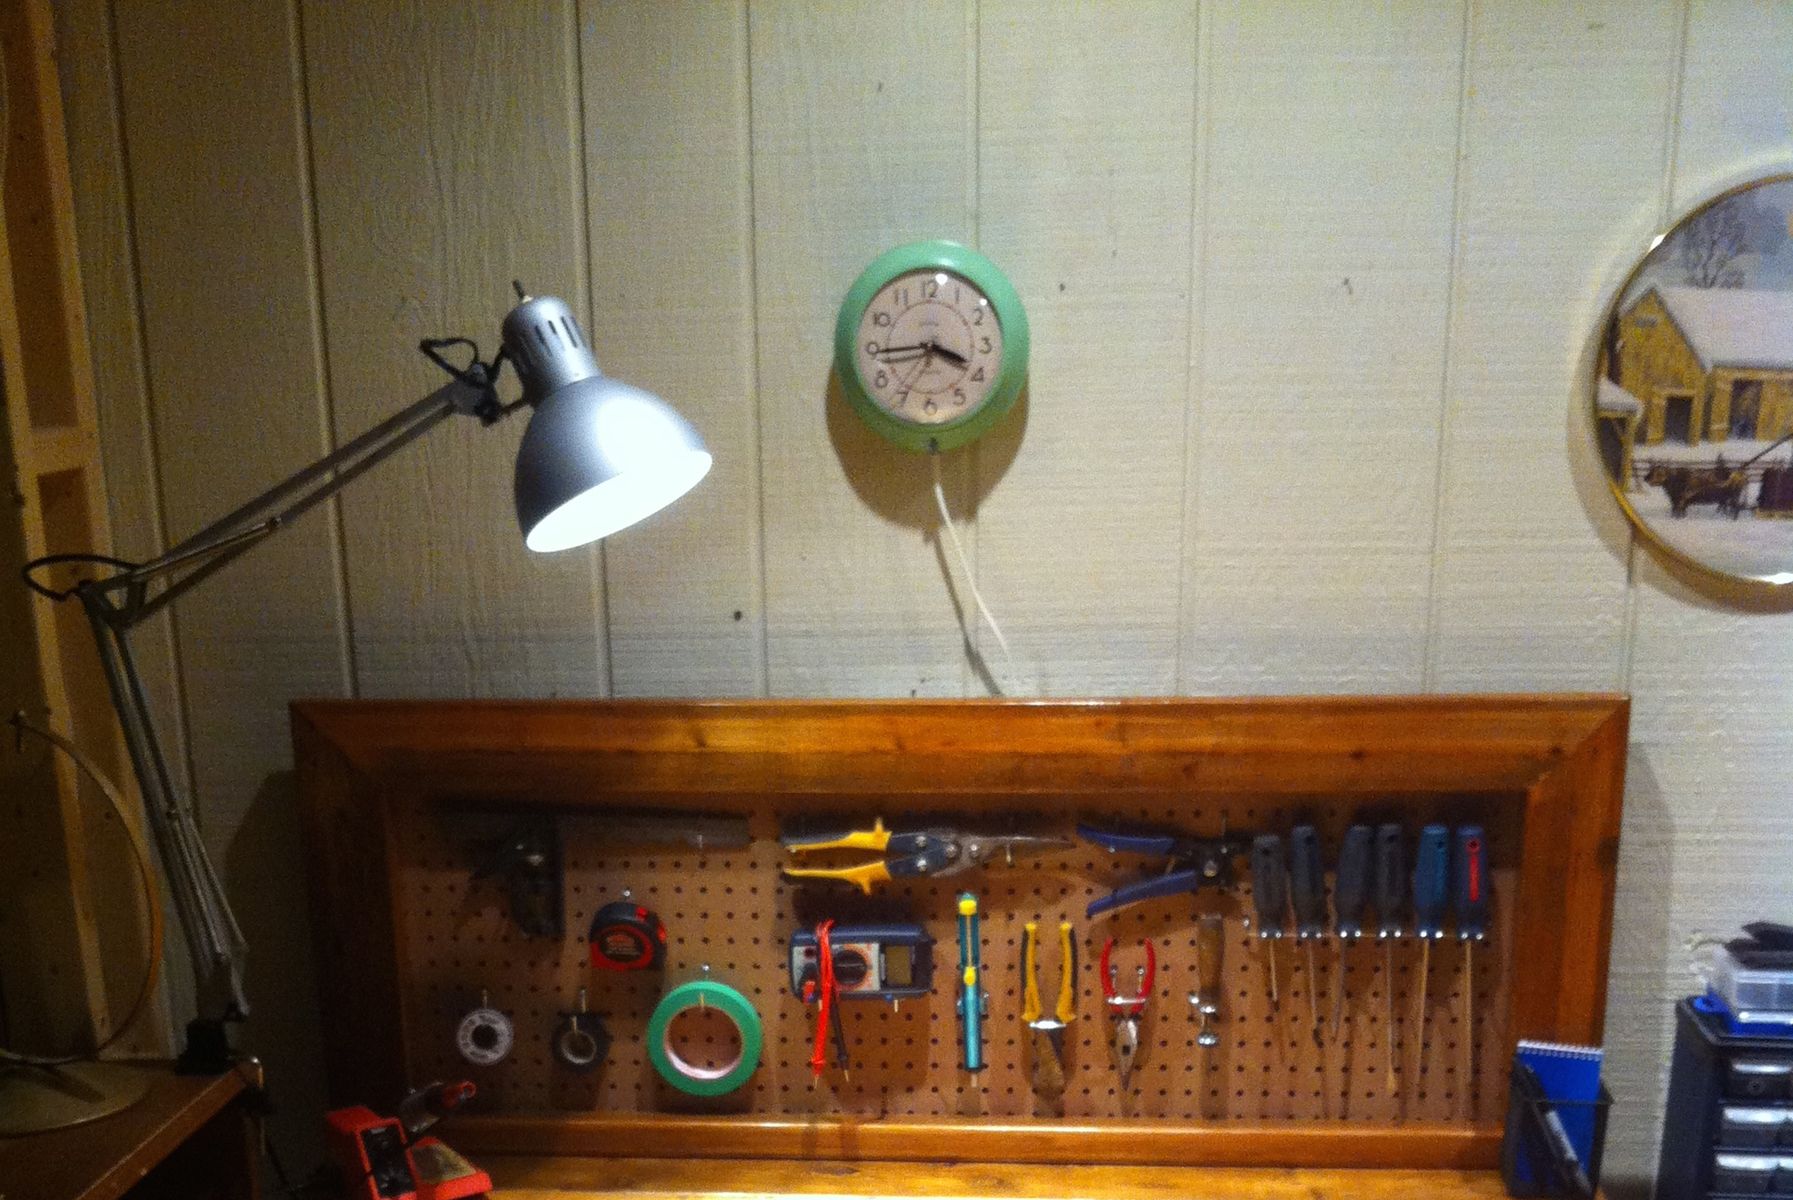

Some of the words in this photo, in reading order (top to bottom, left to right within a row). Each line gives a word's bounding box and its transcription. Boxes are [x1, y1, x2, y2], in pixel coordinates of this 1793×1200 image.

[894, 288, 908, 306] 11
[921, 279, 939, 298] 12
[872, 311, 890, 328] 10
[972, 308, 984, 326] 2
[979, 336, 993, 355] 3
[875, 369, 889, 389] 8
[970, 367, 984, 383] 4
[896, 391, 910, 407] 7
[953, 388, 967, 406] 5
[923, 398, 938, 416] 6
